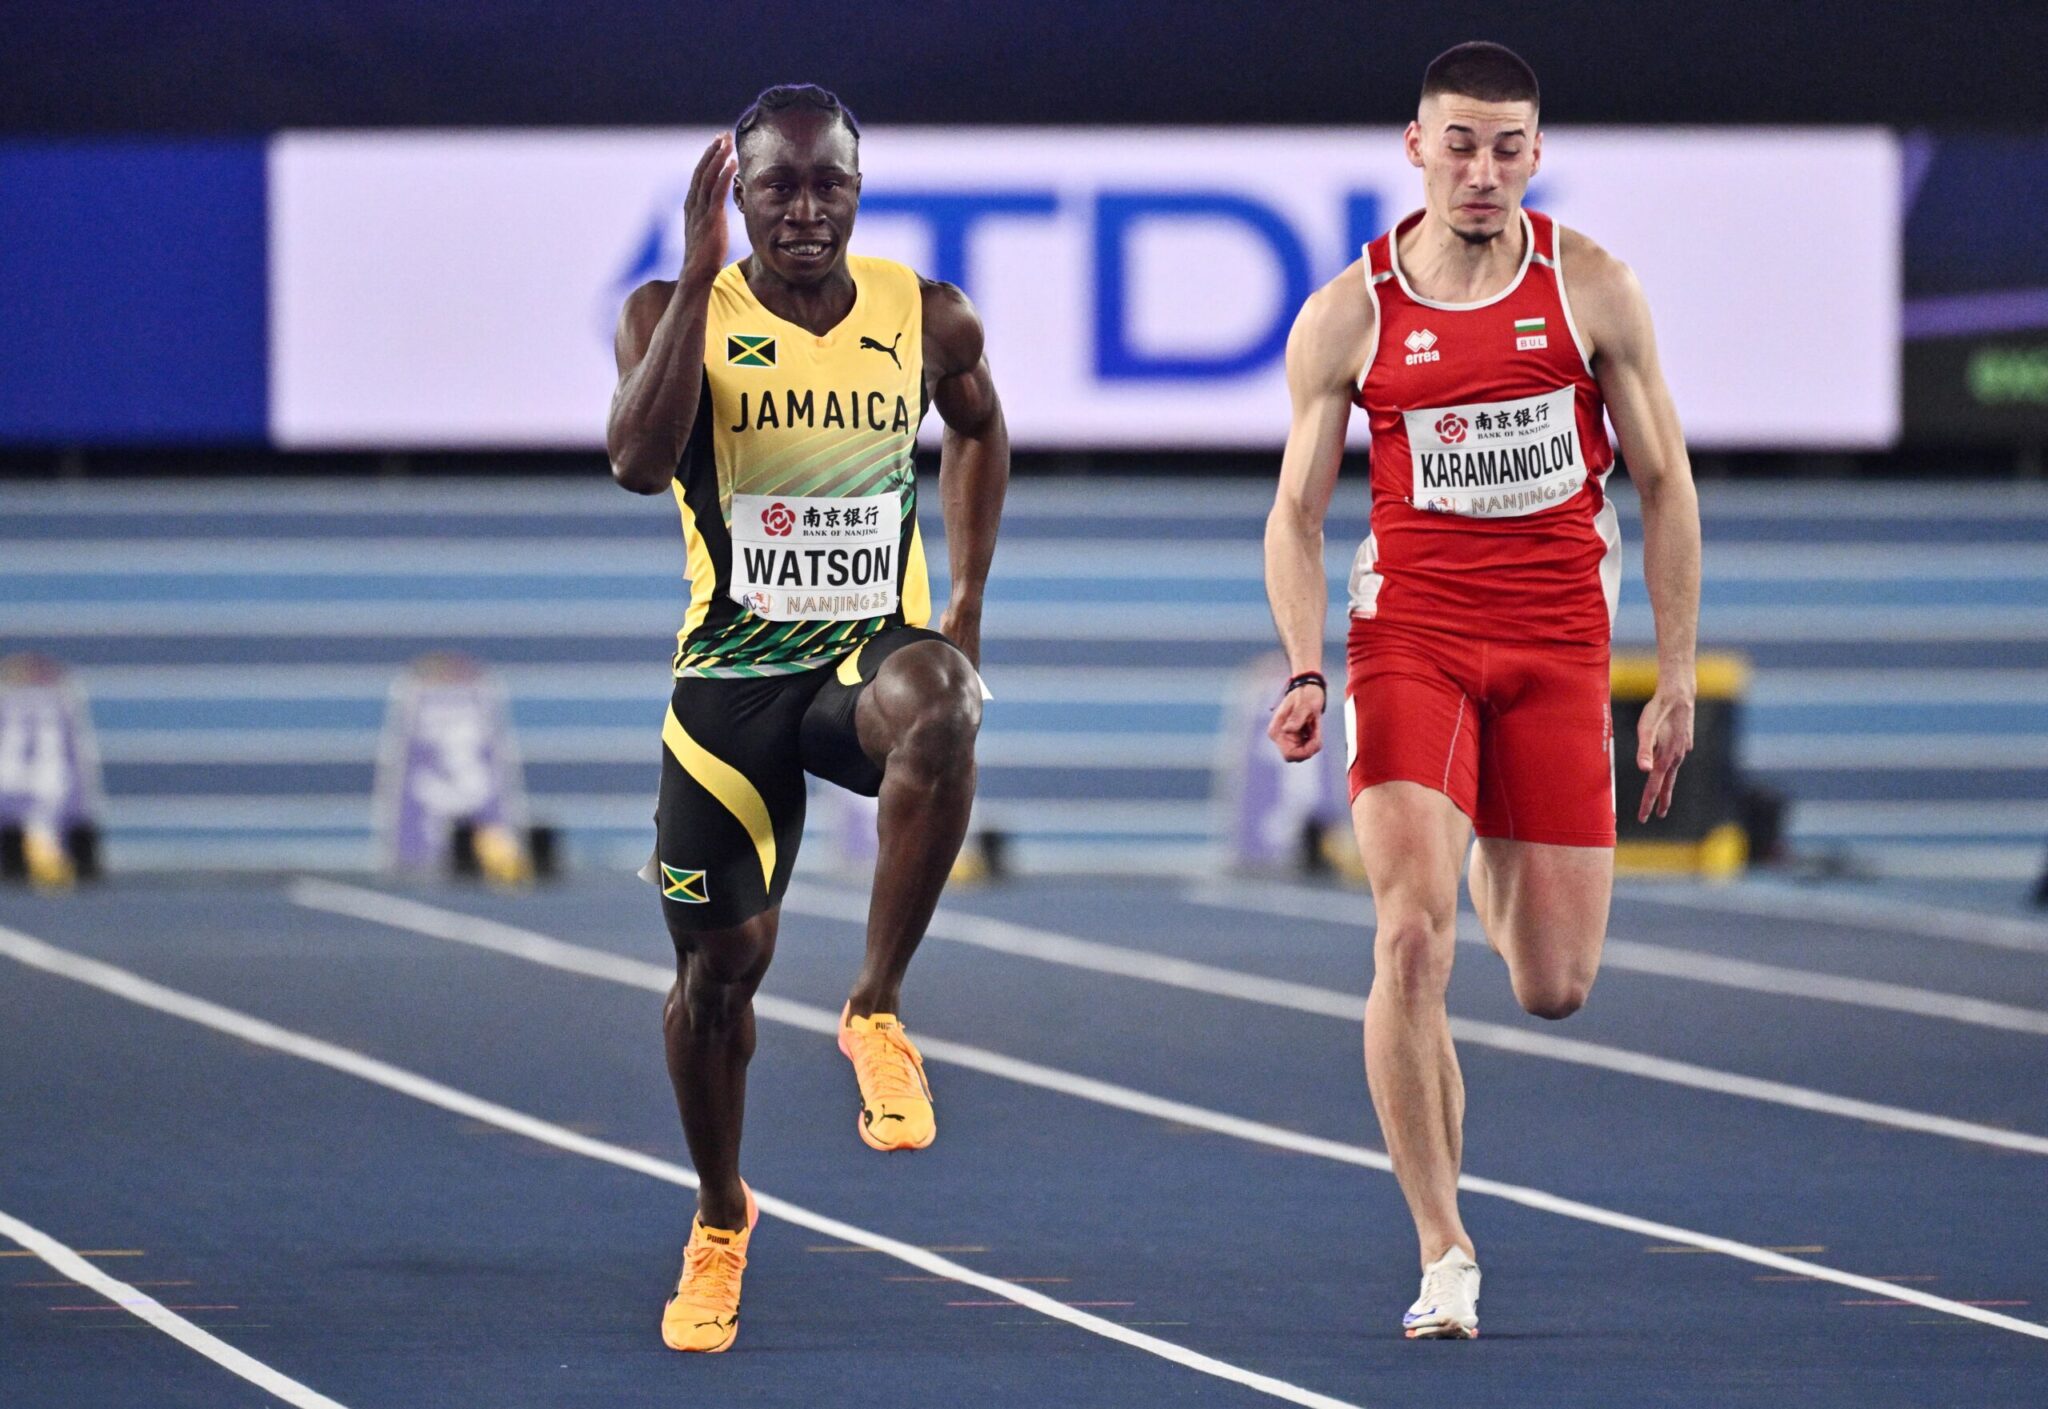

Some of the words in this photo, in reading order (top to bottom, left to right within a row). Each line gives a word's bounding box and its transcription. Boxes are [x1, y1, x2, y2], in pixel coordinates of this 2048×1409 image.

[852, 187, 1545, 383] TD
[1520, 338, 1545, 349] BUL
[731, 389, 909, 435] JAMAICA
[1475, 403, 1550, 431] 南京银行
[1477, 431, 1501, 440] BANK
[1518, 423, 1551, 436] NANJING
[1421, 431, 1575, 488] KARAMANOLOV
[802, 505, 879, 528] 南京银行
[803, 529, 827, 537] BANK
[830, 529, 841, 537] OF
[844, 528, 879, 537] NANJING
[743, 545, 891, 586] WATSON
[706, 1233, 730, 1246] PUMA
